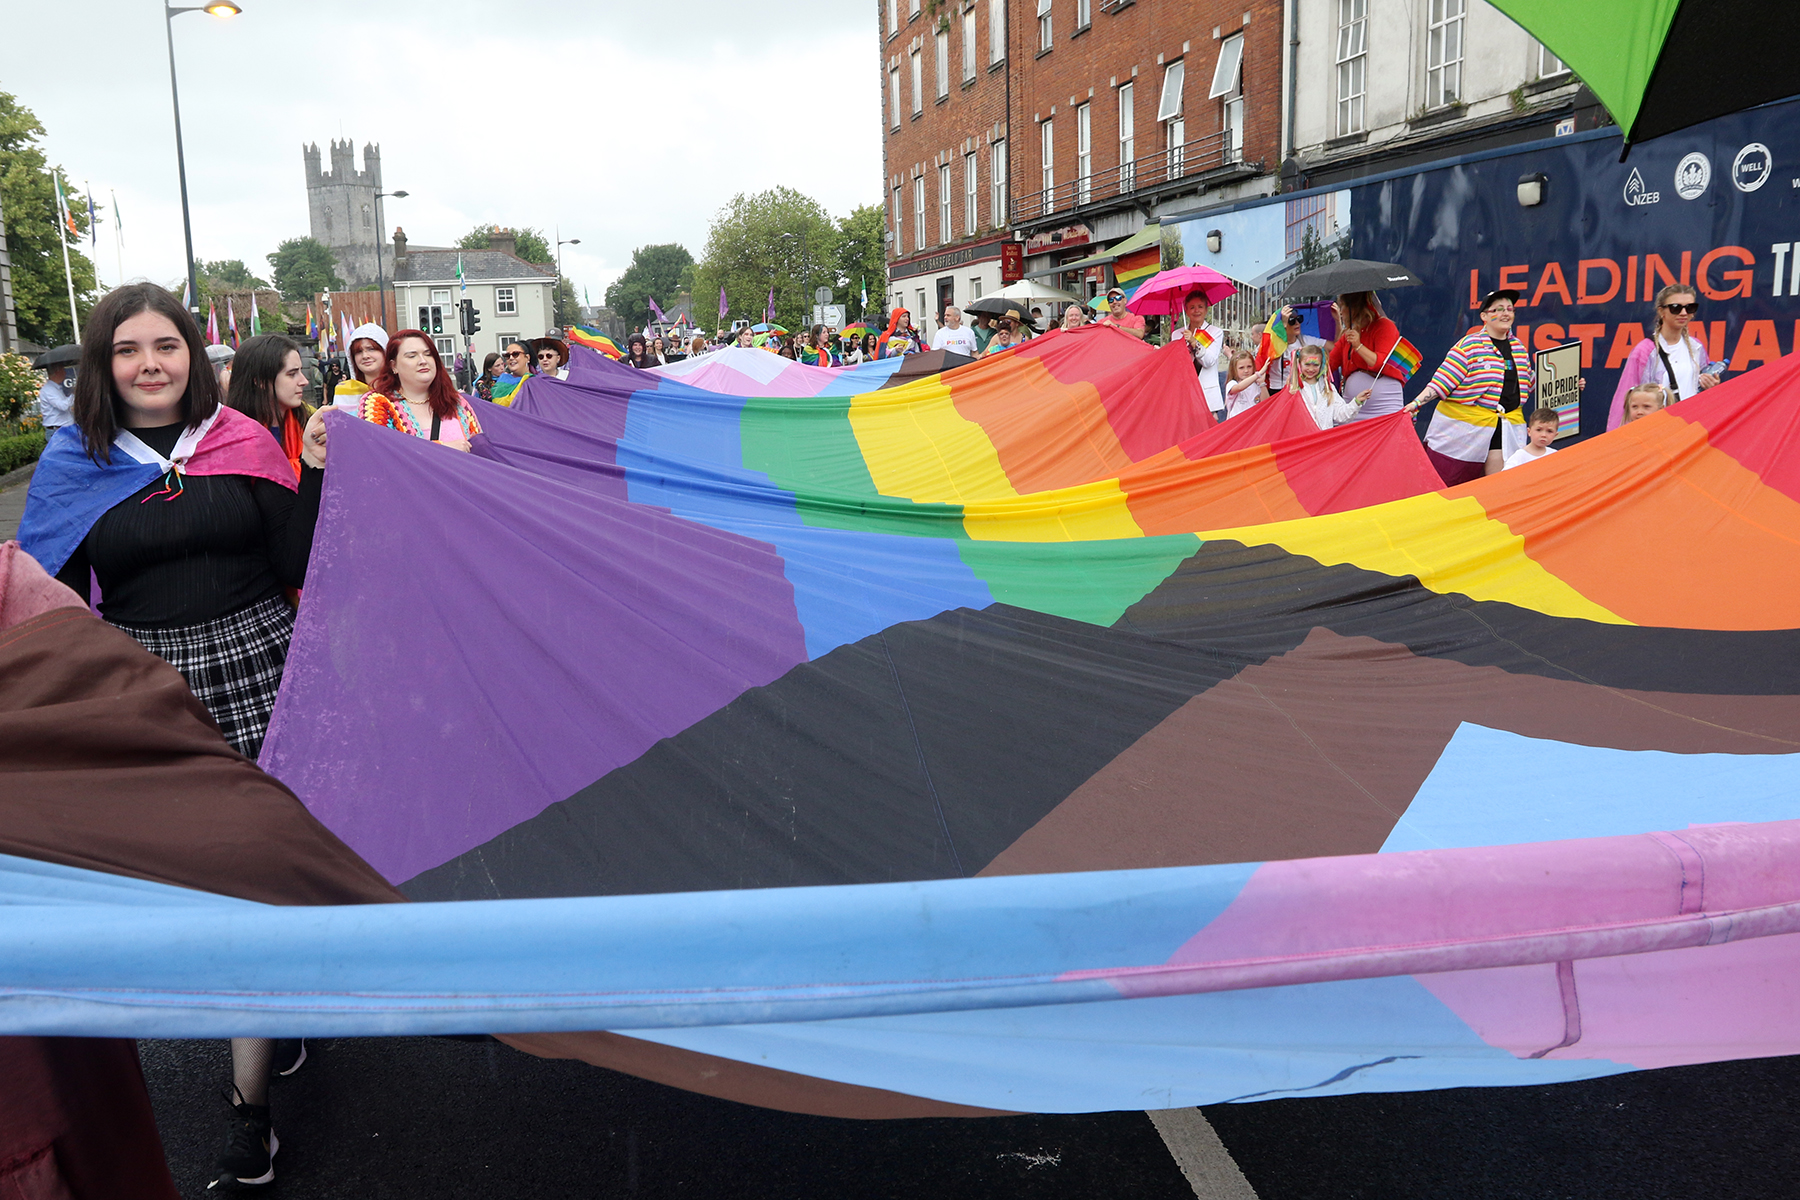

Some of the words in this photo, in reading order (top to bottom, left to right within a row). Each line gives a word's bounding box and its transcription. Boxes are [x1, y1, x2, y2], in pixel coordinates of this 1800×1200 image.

[1741, 162, 1763, 173] WELL
[1633, 192, 1660, 206] NZEB
[1469, 246, 1756, 309] LEADING
[1541, 381, 1553, 398] NO
[1555, 375, 1578, 395] PRIDE
[1542, 397, 1549, 408] IN
[1550, 391, 1578, 408] GENOCIDE
